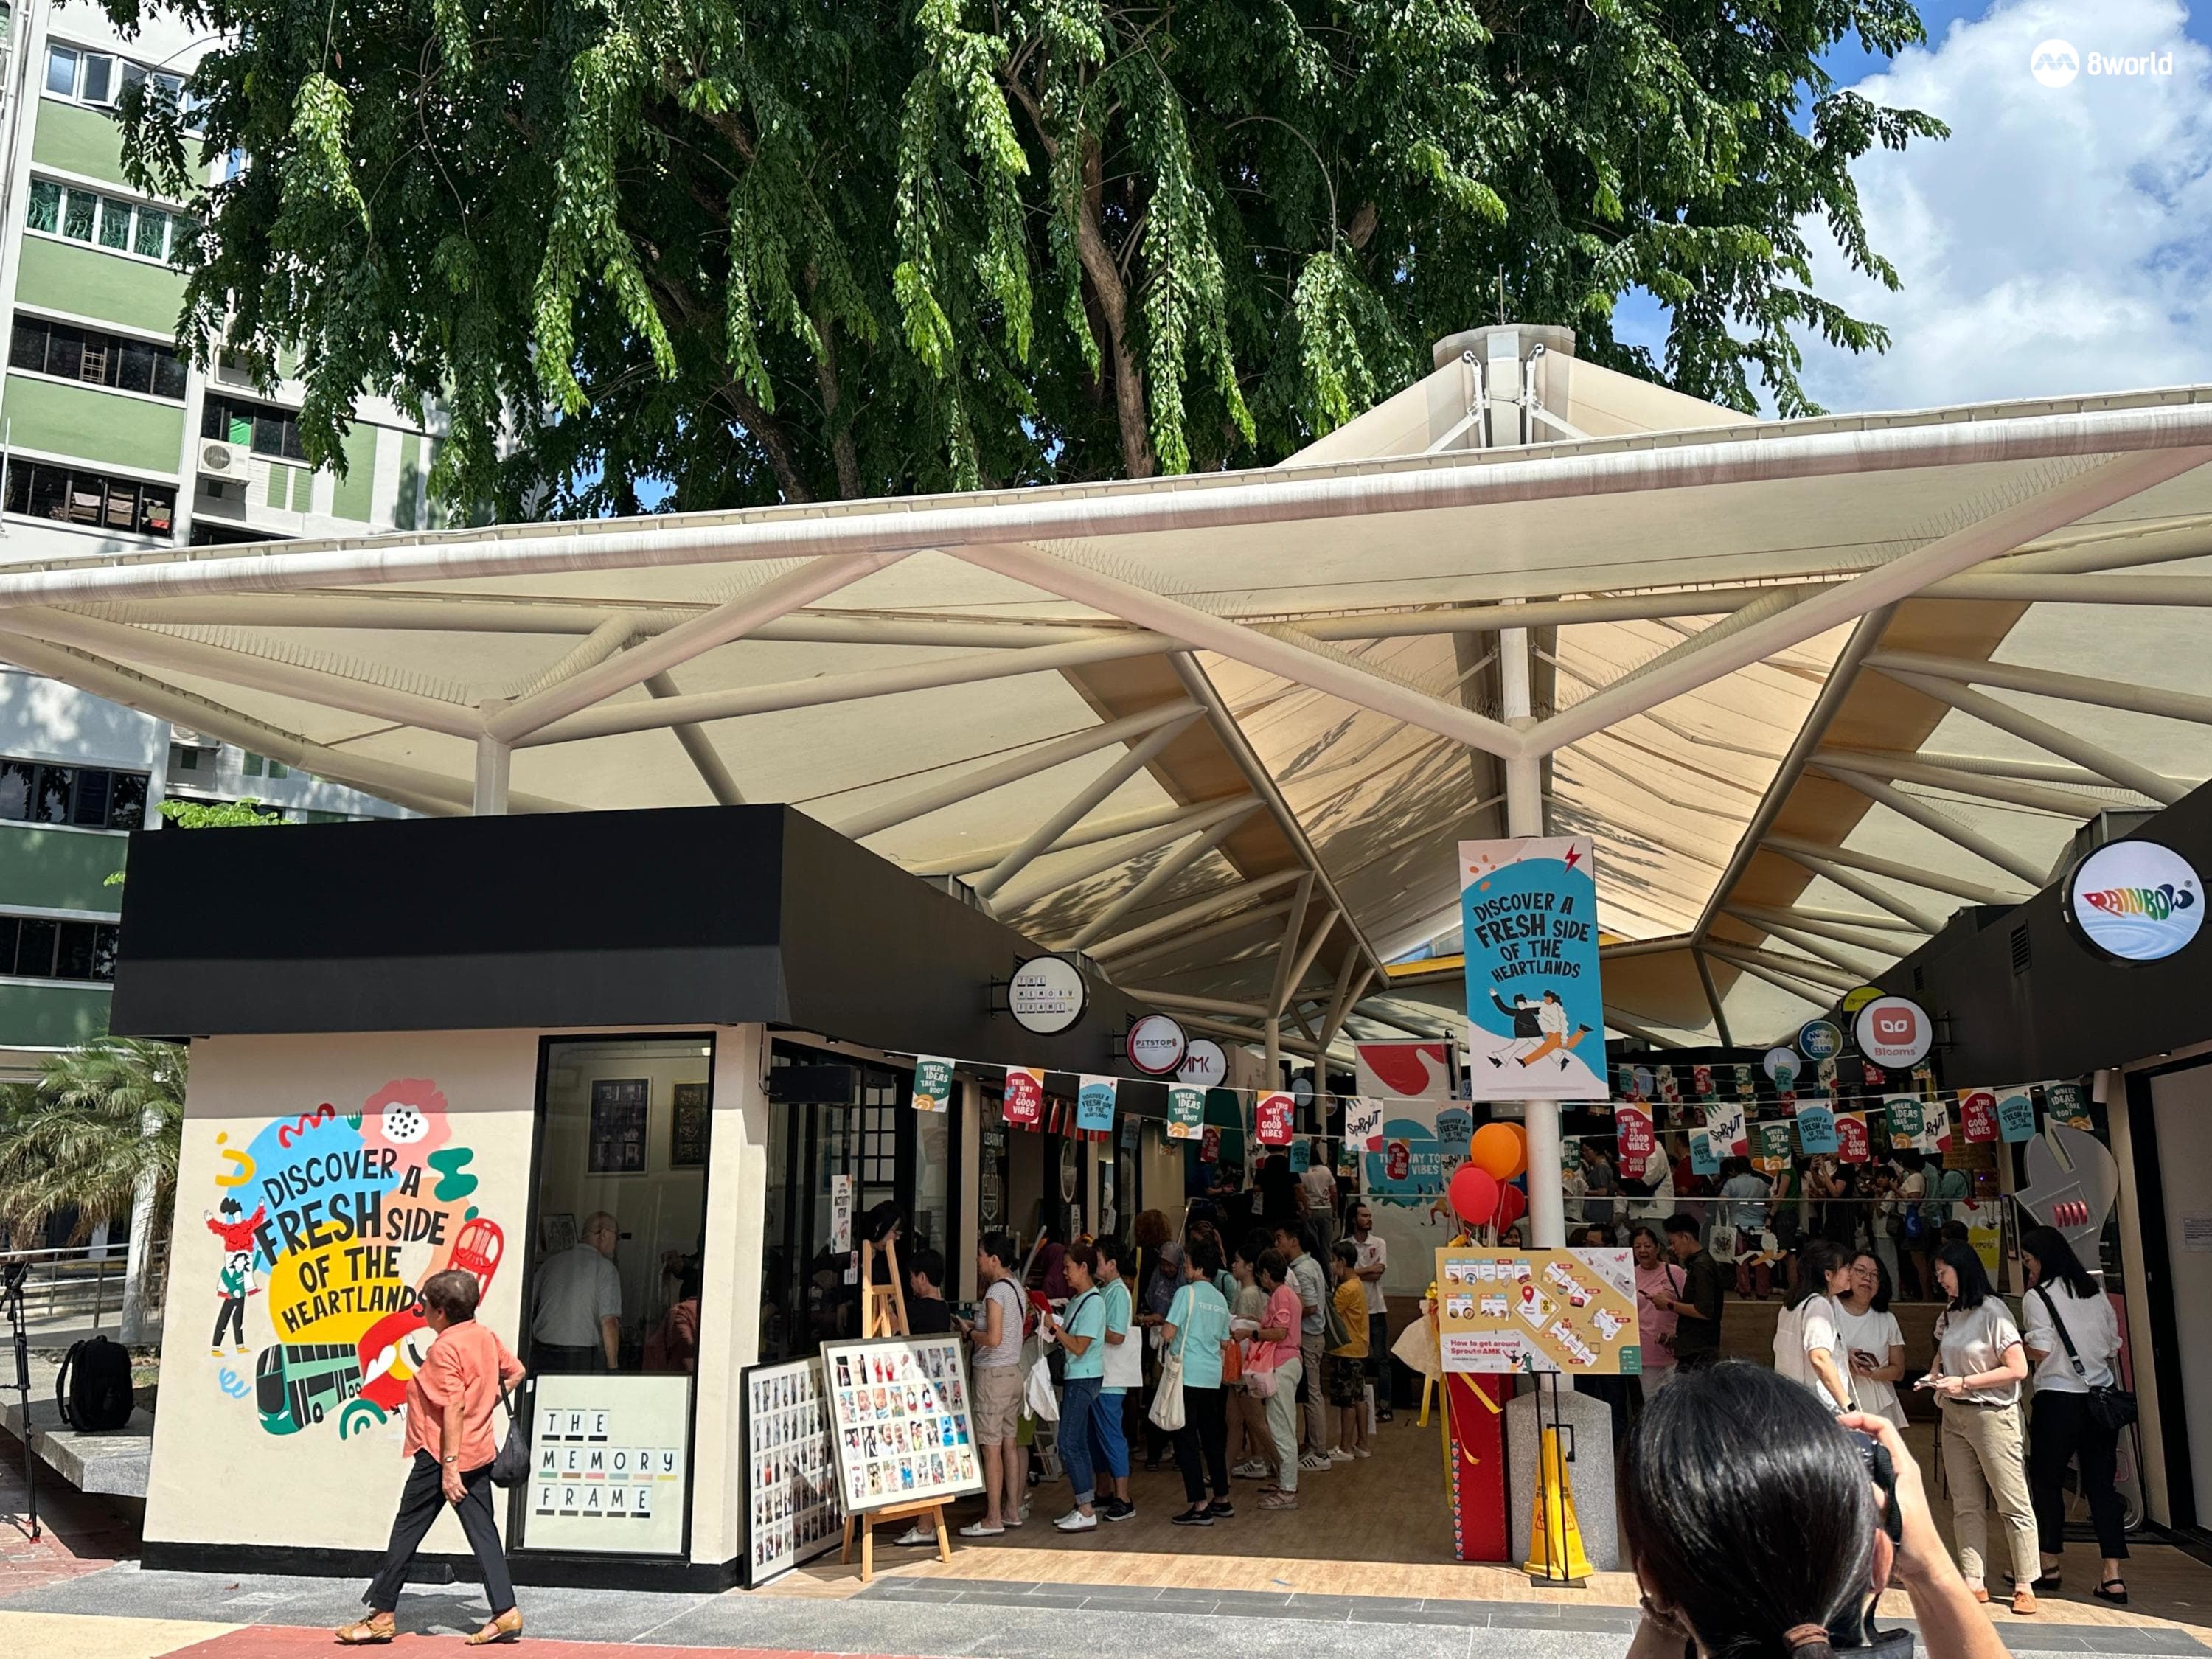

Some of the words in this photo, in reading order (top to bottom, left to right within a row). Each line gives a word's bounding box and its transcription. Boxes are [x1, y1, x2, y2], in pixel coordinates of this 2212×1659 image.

[2081, 883, 2194, 921] RAINBOW
[1472, 892, 1555, 923] DISCOVER
[1559, 896, 1574, 916] A
[1474, 913, 1546, 950] FRESH
[1552, 919, 1591, 943] SIDE
[1500, 943, 1520, 963] OF
[1528, 939, 1564, 959] THE
[1490, 959, 1581, 984] HEARTLANDS
[1875, 1047, 1916, 1057] Blooms
[922, 1065, 945, 1074] WHERE
[1180, 1056, 1209, 1073] AMK
[925, 1072, 948, 1082] IDEAS
[1011, 1078, 1026, 1086] THIS
[929, 1087, 945, 1095] ROOT
[2053, 1088, 2076, 1096] WHERE
[1175, 1093, 1196, 1101] WHERE
[2051, 1095, 2076, 1105] IDEAS
[1015, 1099, 1036, 1107] GOOD
[1178, 1099, 1201, 1110] IDEAS
[1275, 1102, 1289, 1110] THIS
[1890, 1102, 1911, 1110] WHERE
[1976, 1099, 1990, 1107] THIS
[1012, 1106, 1035, 1116] VIBES
[1265, 1107, 1281, 1116] WAY
[1895, 1109, 1918, 1118] IDEAS
[1968, 1105, 1983, 1113] WAY
[2056, 1109, 2073, 1117] ROOT
[1183, 1114, 1198, 1122] ROOT
[1272, 1114, 1281, 1122] TO
[1620, 1114, 1634, 1122] THIS
[1967, 1119, 1989, 1127] GOOD
[1262, 1121, 1282, 1130] GOOD
[1346, 1110, 1382, 1138] SPROUT
[1708, 1113, 1742, 1143] SPROUT
[1902, 1123, 1918, 1132] ROOT
[1260, 1128, 1284, 1139] VIBES
[1967, 1126, 1991, 1136] VIBES
[1628, 1134, 1649, 1144] GOOD
[1627, 1142, 1651, 1152] VIBES
[1847, 1147, 1867, 1156] VIBES
[1427, 1153, 1441, 1164] TO
[1629, 1157, 1644, 1165] GOOD
[1411, 1164, 1439, 1175] VIBES
[1627, 1164, 1644, 1172] VIBES
[262, 1147, 397, 1210] DISCOVER
[399, 1165, 422, 1198] A
[254, 1190, 383, 1267] FRESH
[386, 1207, 450, 1246] SIDE
[299, 1253, 330, 1294] OF
[344, 1245, 402, 1282] THE
[281, 1286, 426, 1335] HEARTLANDS
[1450, 1347, 1501, 1356] Sprout@AMK
[548, 1412, 605, 1433] THE
[543, 1450, 674, 1471] MEMORY
[541, 1488, 648, 1509] FRAME
